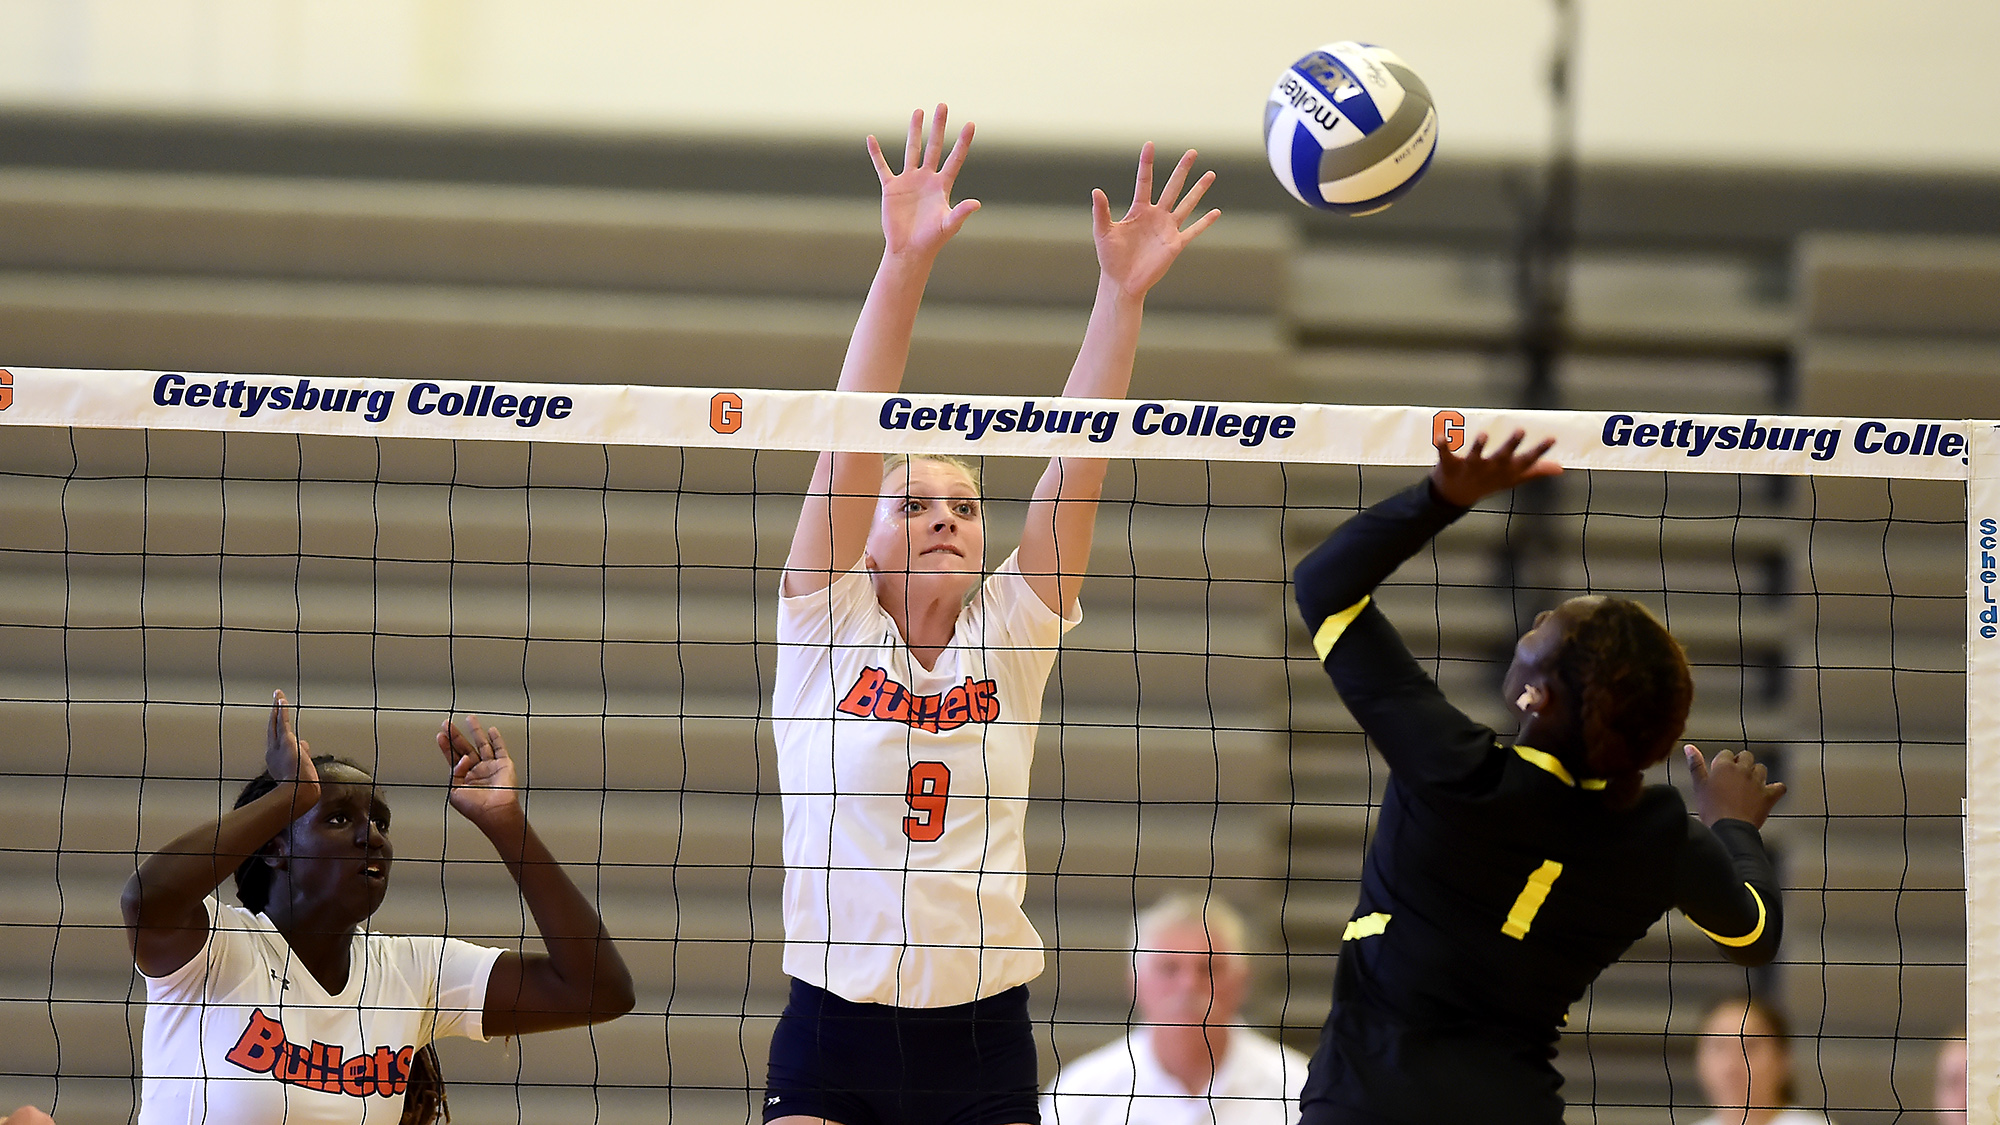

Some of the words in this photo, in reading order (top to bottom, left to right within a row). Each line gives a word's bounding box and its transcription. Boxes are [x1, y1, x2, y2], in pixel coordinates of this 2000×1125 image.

[153, 374, 395, 422] Gettysburg
[407, 382, 573, 427] College
[710, 392, 743, 434] G
[879, 397, 1120, 443] Gettysburg
[1131, 403, 1296, 447] College
[1432, 410, 1465, 452] G
[1601, 414, 1842, 461] Gettysburg
[1854, 421, 1968, 466] Colle
[836, 665, 1001, 735] Bullets
[902, 761, 951, 842] 9
[1501, 858, 1563, 941] 1
[224, 1007, 415, 1098] Bullets
